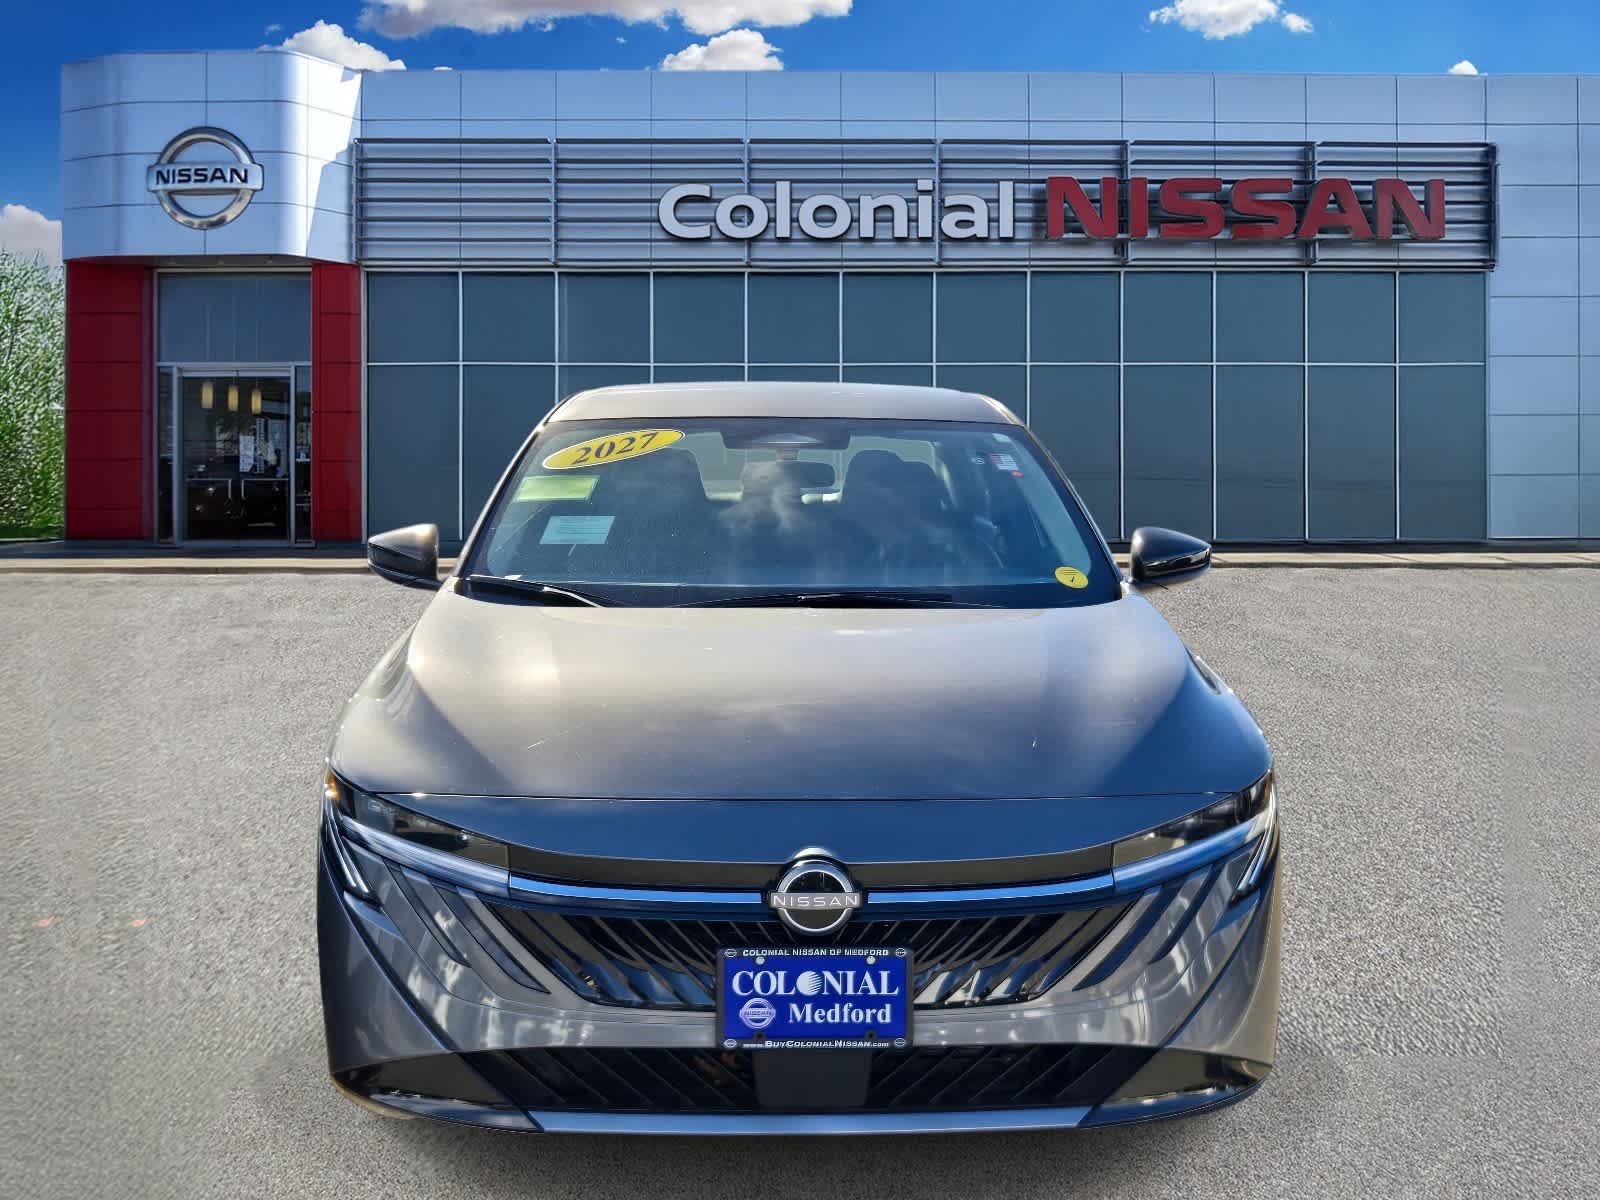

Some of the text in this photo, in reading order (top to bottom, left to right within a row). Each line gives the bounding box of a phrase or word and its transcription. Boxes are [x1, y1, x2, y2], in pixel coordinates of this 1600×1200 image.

[155, 167, 248, 185] NISSAN
[657, 176, 1446, 240] Colonial NISSAN
[570, 431, 660, 465] 2027
[773, 895, 858, 907] NISSAN
[742, 949, 790, 957] COLONIAL
[792, 948, 827, 956] NISSAN
[844, 948, 889, 956] MEDFORD
[731, 970, 899, 996] COLONIAL
[788, 1002, 892, 1024] Medford
